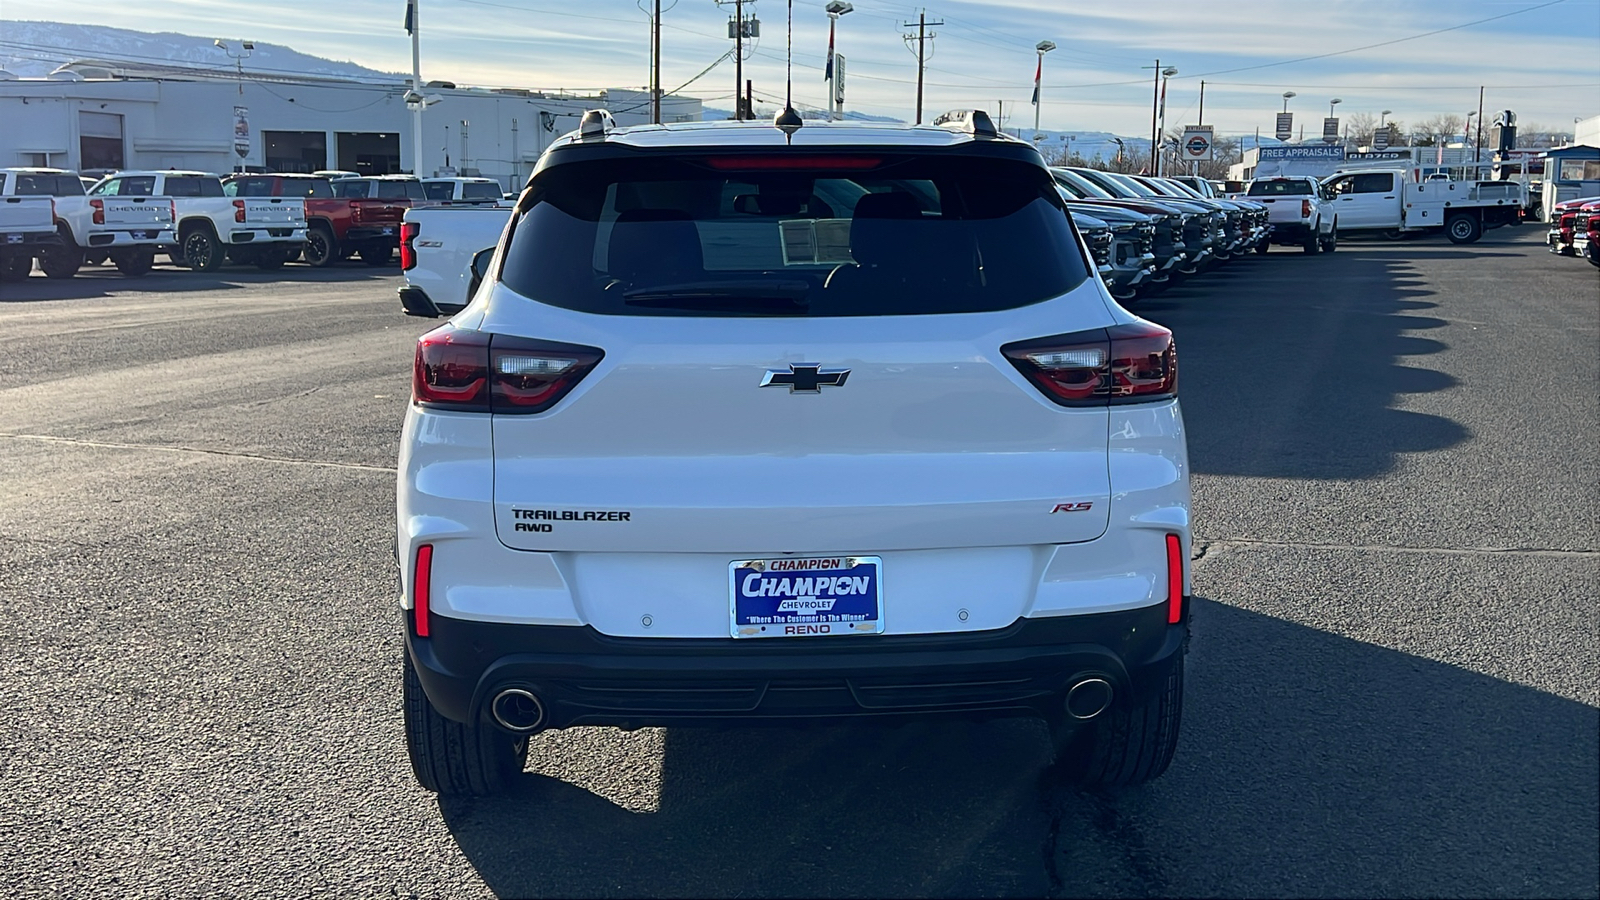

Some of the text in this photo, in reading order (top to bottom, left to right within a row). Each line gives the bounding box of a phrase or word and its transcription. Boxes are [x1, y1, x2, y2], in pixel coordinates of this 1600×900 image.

[1261, 147, 1343, 158] FREE APPRAISALS!
[1049, 502, 1093, 513] RS
[511, 509, 631, 522] TRAILBLAZER
[515, 523, 552, 533] AWD
[770, 558, 841, 571] CHAMPION
[781, 601, 832, 609] CHEVROLET
[773, 615, 786, 623] The
[787, 615, 819, 623] Customer
[828, 614, 841, 622] The
[785, 624, 831, 635] RENO
